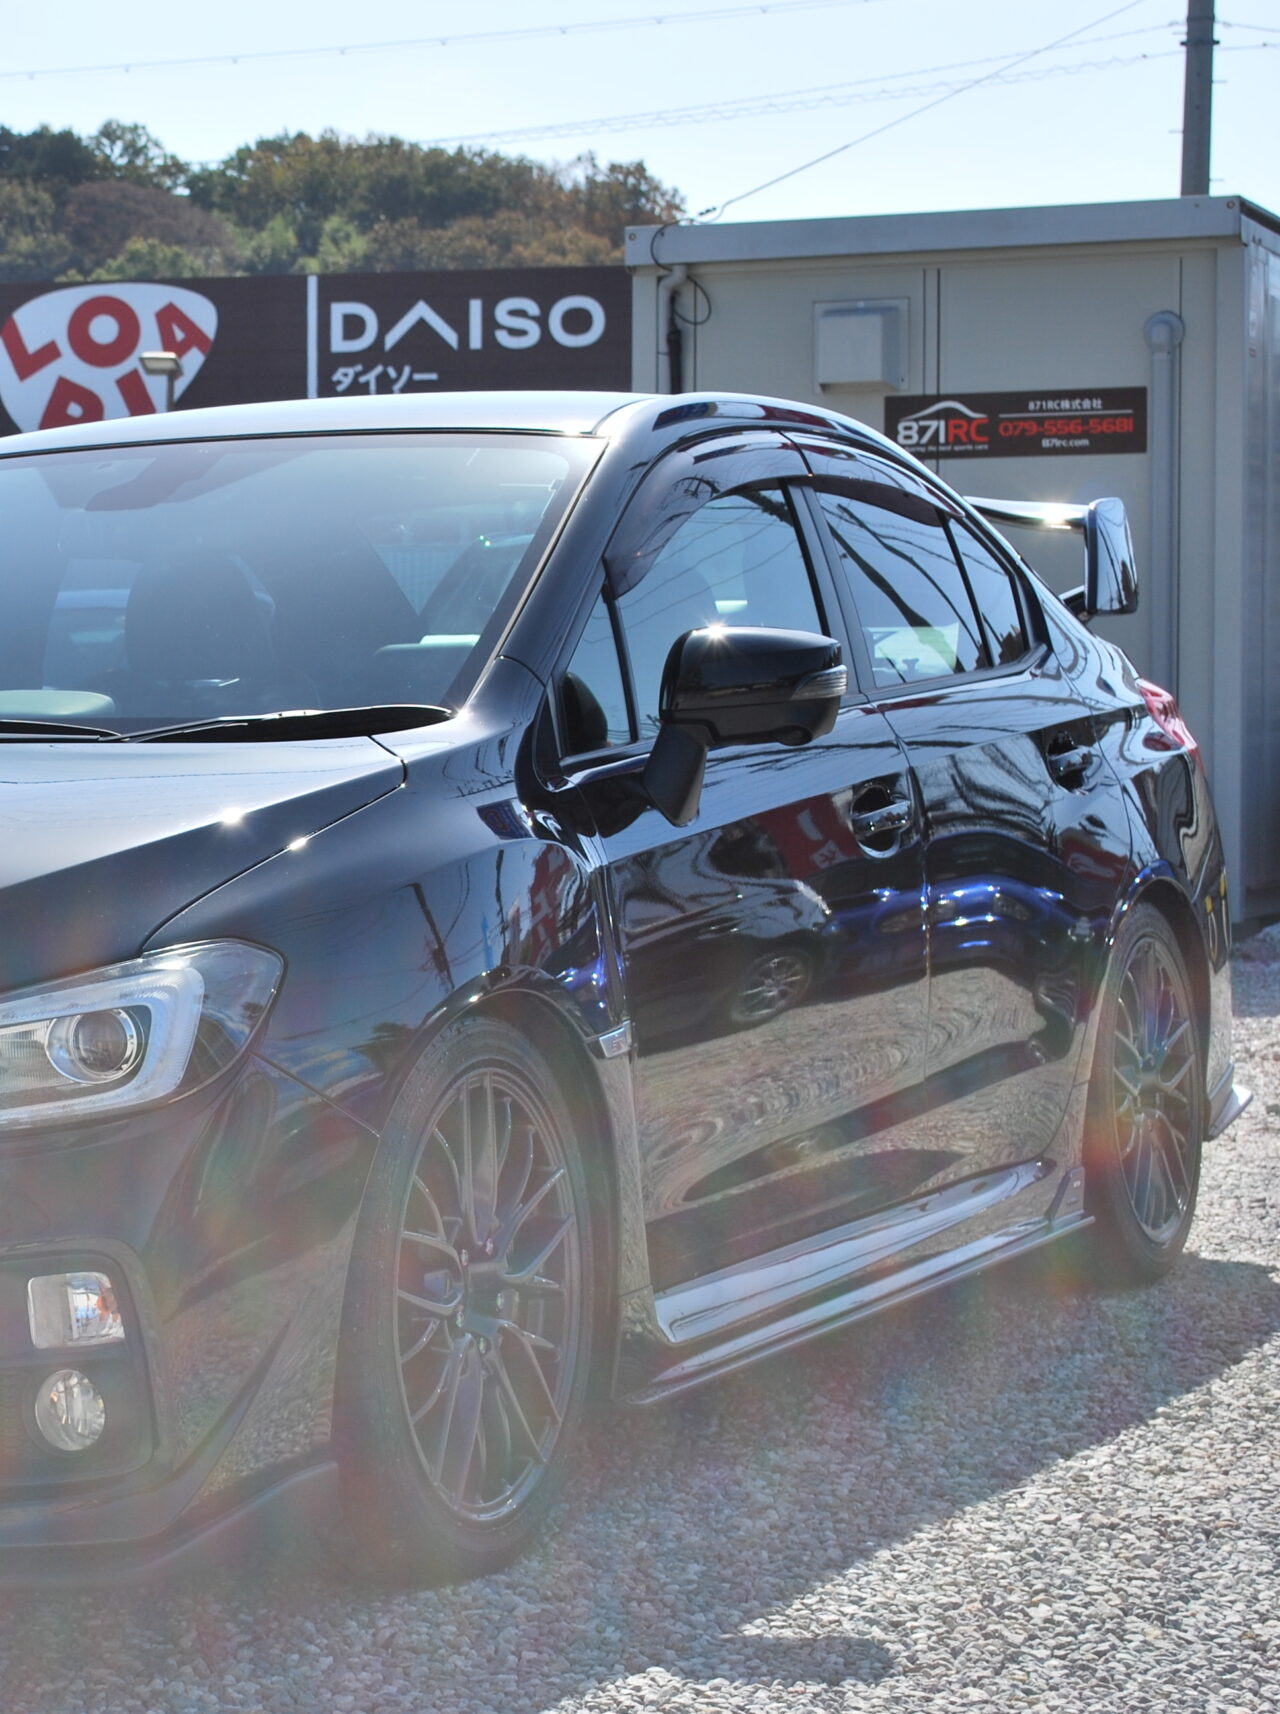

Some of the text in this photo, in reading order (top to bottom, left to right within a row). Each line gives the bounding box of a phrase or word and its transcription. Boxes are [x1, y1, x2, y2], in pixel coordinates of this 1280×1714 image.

[330, 295, 606, 352] DAISO
[331, 363, 439, 395] ダイソー
[897, 418, 990, 445] 871RC
[998, 417, 1135, 437] 079-556-5681
